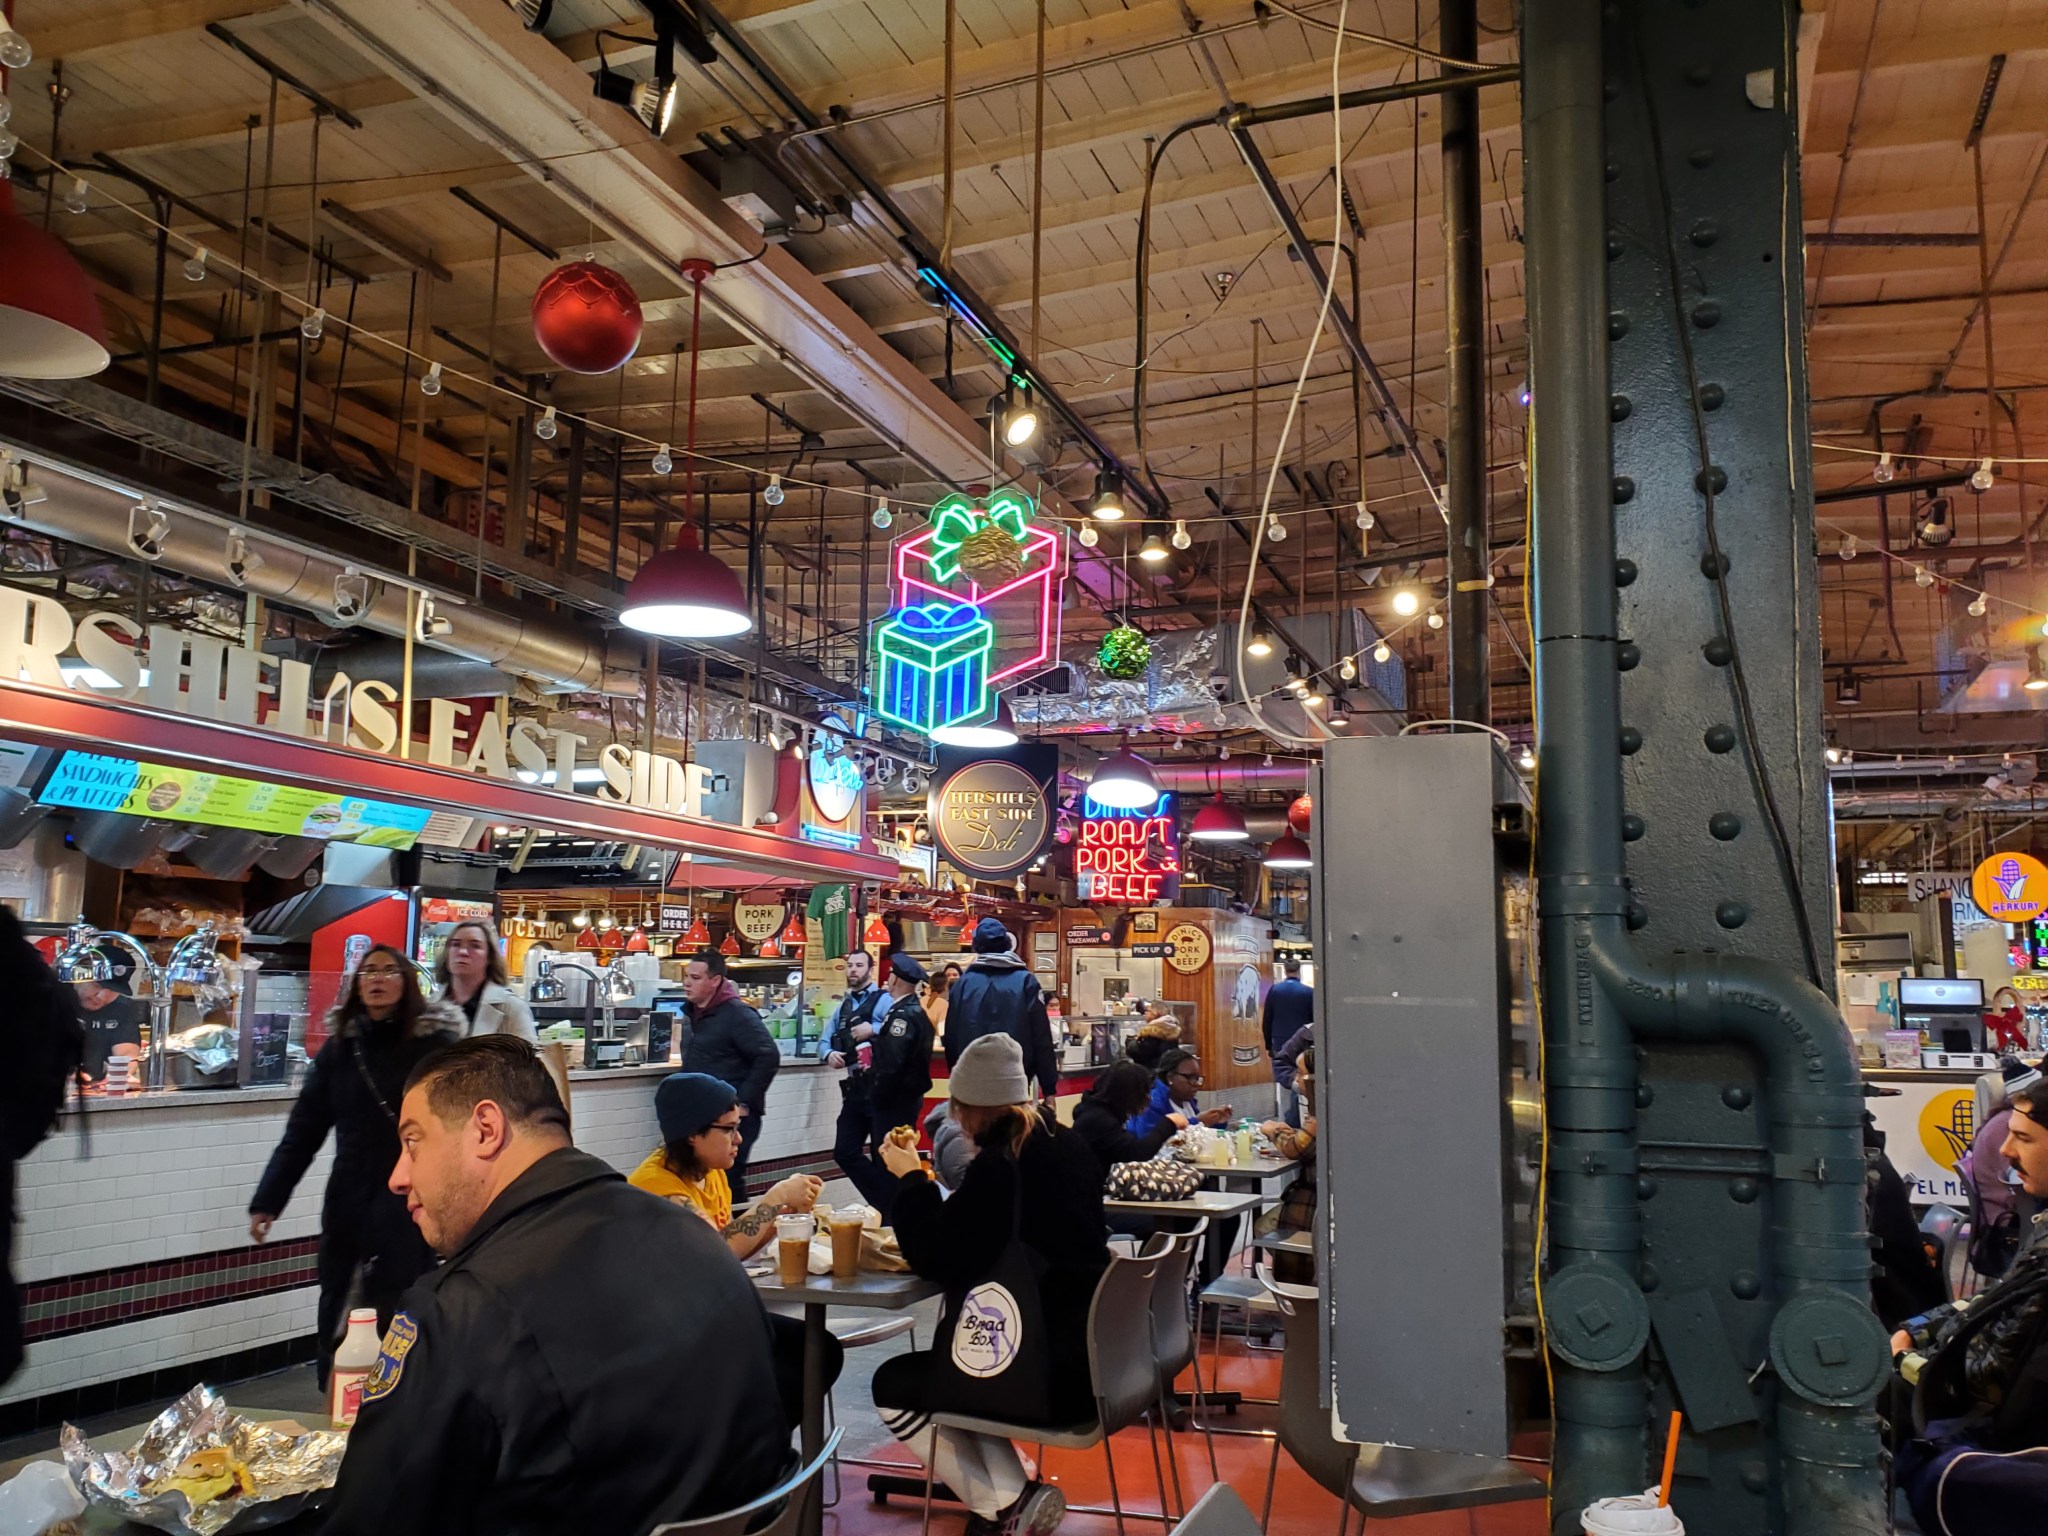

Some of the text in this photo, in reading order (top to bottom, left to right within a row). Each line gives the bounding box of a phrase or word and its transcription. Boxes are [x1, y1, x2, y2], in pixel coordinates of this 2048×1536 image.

[428, 697, 588, 792] EAST
[597, 742, 713, 820] SIDE
[58, 762, 155, 791] SANDWICHES
[60, 784, 139, 810] PLATTERS
[950, 786, 1038, 805] HERSHEL'S
[950, 807, 1037, 821] EAST SIDE
[957, 819, 1025, 852] Deli
[1082, 818, 1171, 846] ROAST
[1076, 847, 1148, 874] PORK
[1090, 873, 1162, 900] BEEF
[456, 907, 489, 918] ICE COLD
[662, 908, 689, 919] ORDER
[744, 908, 775, 919] PORK
[500, 918, 536, 938] UCE
[746, 923, 772, 933] BEEF
[1066, 930, 1089, 938] ORDER
[1133, 946, 1161, 954] PICK UP
[1175, 946, 1201, 954] PORK
[1176, 957, 1199, 966] BEEF
[1917, 1180, 1939, 1195] EL
[962, 1315, 1007, 1331] Bread
[968, 1330, 997, 1347] Box
